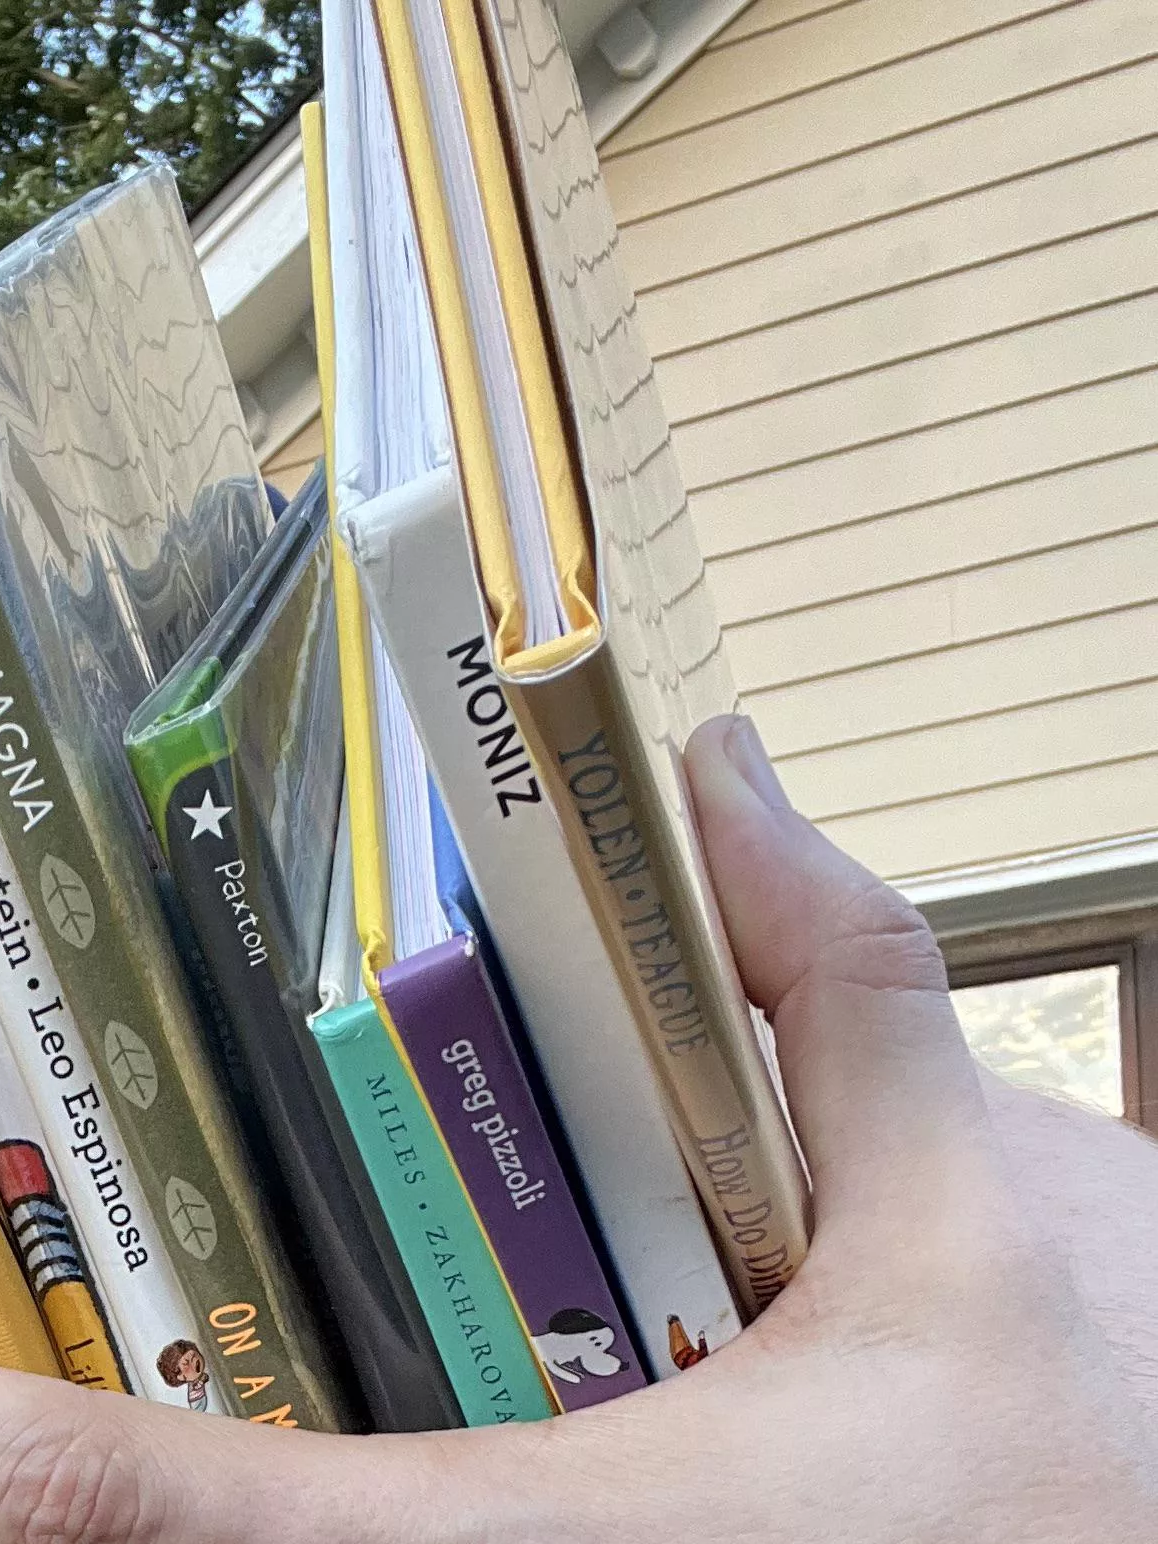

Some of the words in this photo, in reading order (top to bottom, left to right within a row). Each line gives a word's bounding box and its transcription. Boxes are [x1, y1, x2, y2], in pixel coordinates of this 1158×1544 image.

[447, 635, 542, 819] MONIZ
[558, 729, 650, 882] YOLEN
[622, 902, 711, 1058] TEAGUE
[27, 996, 75, 1080] Leo
[62, 1083, 149, 1273] Espinosa
[441, 1037, 497, 1114] greg
[471, 1112, 547, 1211] pizzoli
[699, 1127, 752, 1202] How
[366, 1072, 426, 1186] MILES
[425, 1226, 516, 1424] ZAKHAROVA
[723, 1199, 773, 1245] Do
[208, 1302, 262, 1356] ON
[233, 1375, 275, 1399] A
